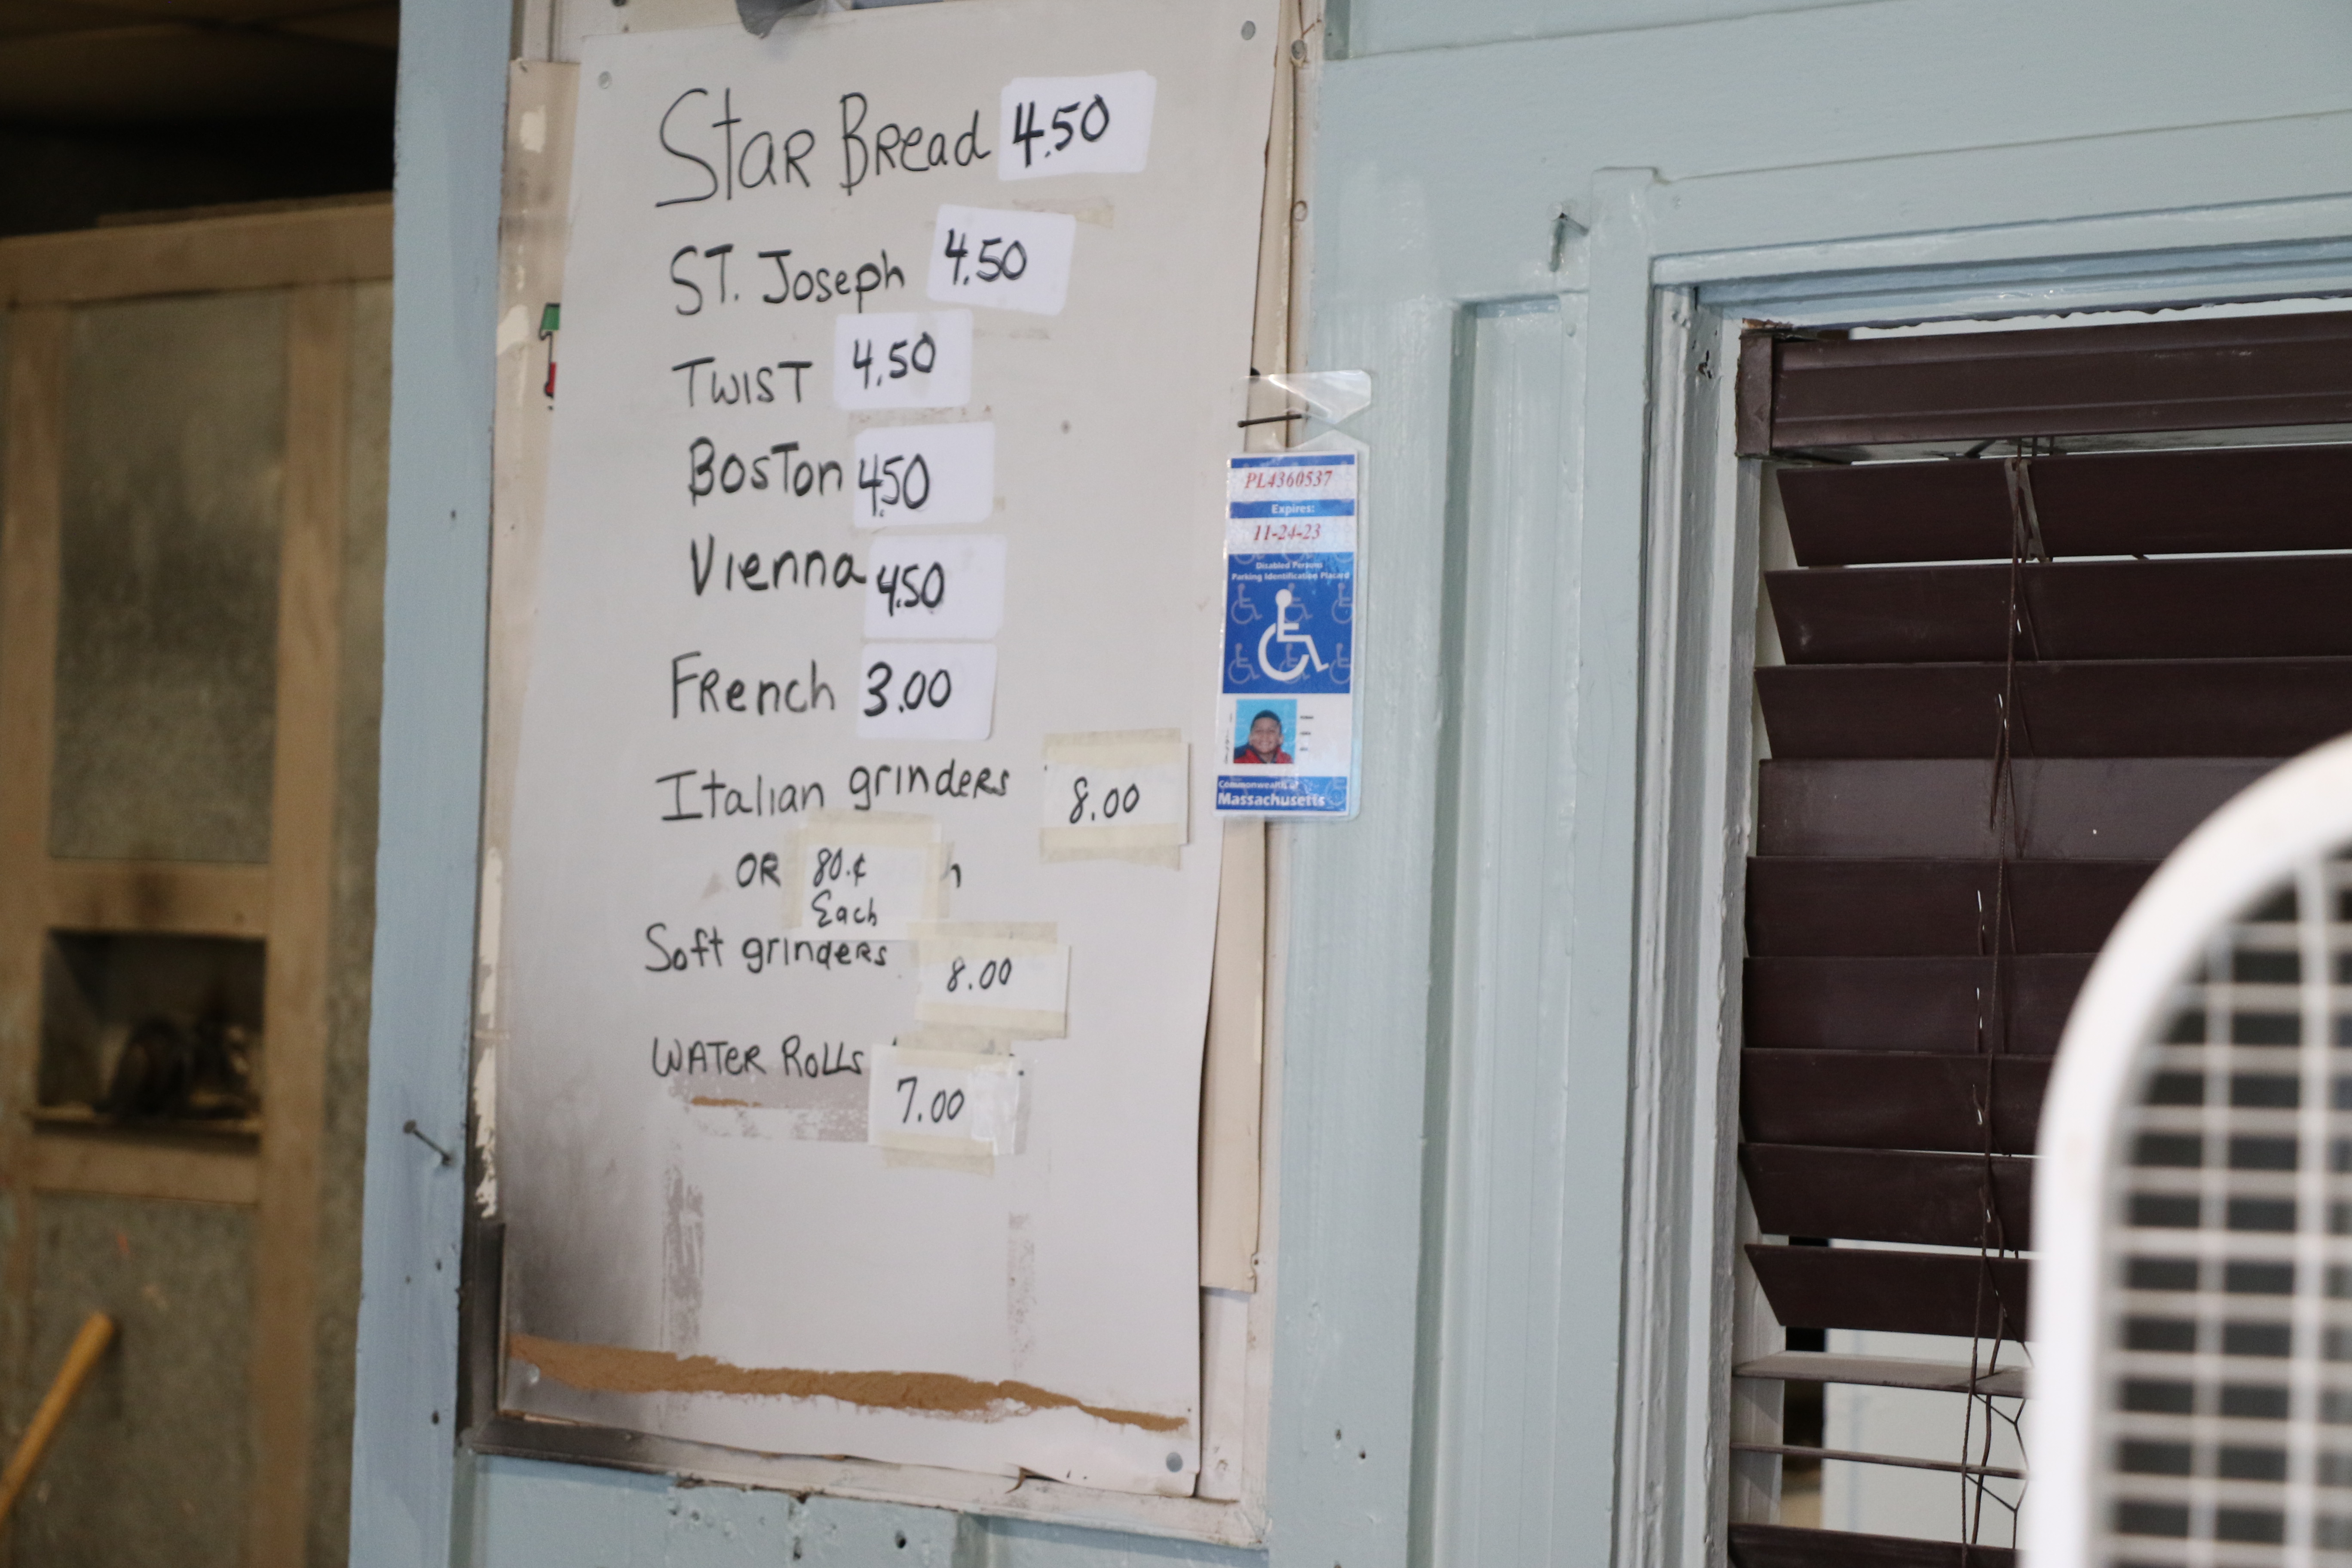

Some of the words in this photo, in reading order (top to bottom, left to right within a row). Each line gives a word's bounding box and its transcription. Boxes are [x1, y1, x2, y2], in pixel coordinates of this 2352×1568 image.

[1011, 93, 1111, 168] 4.50
[670, 243, 739, 316] ST.
[757, 248, 905, 314] Joseph
[943, 228, 1028, 286] 4.50
[852, 331, 937, 390] 4.50
[858, 453, 931, 518] 4.50
[1245, 471, 1333, 488] PL4360537
[1254, 524, 1321, 540] 11-24-23
[1271, 504, 1315, 514] Expires:
[876, 561, 946, 618] 4.50
[1231, 573, 1262, 582] Parking
[1265, 572, 1318, 581] Identification
[863, 660, 952, 718] 3.00
[655, 769, 824, 822] Italian
[1069, 776, 1140, 825] 8.00
[1218, 793, 1326, 806] Massachusetts
[1219, 780, 1287, 789] Commonwealth
[736, 851, 781, 888] OR
[811, 888, 878, 929] Each
[645, 922, 724, 973] Soft
[946, 957, 1013, 993] 8.00
[897, 1075, 965, 1124] 7.00
